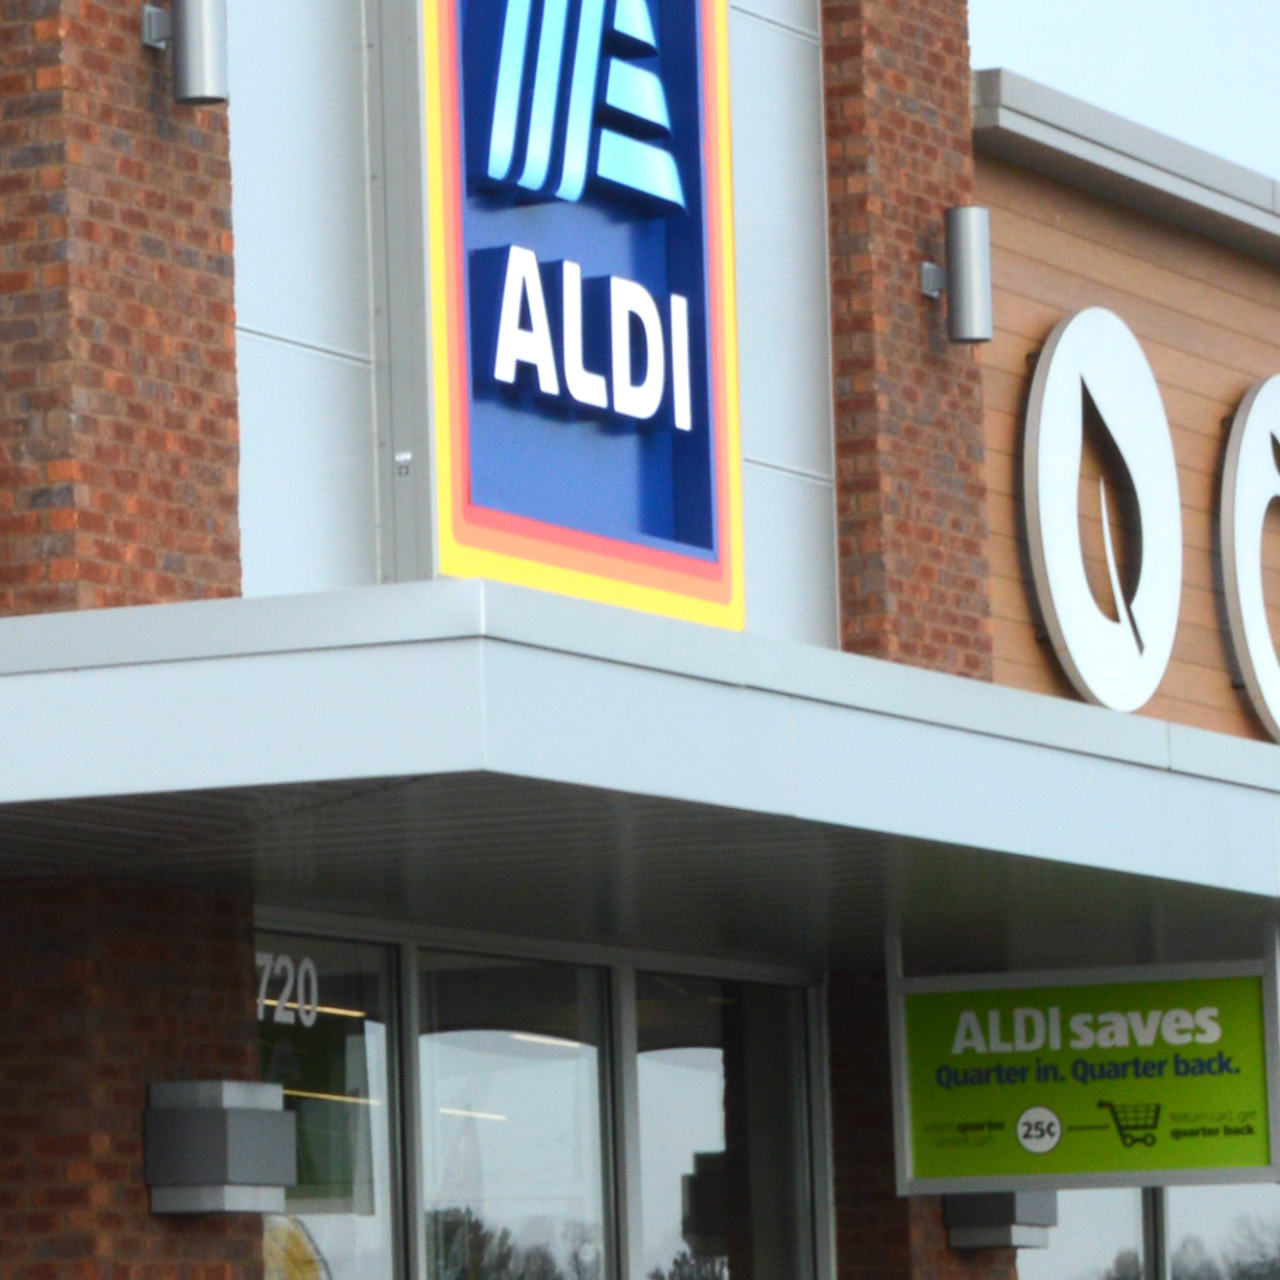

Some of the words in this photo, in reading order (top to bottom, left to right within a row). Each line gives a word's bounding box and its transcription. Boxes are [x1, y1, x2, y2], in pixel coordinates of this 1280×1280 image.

[494, 244, 692, 432] ALDI
[255, 951, 318, 1028] 720
[951, 1006, 1062, 1055] ALDI
[1069, 1006, 1222, 1050] saves
[935, 1063, 1029, 1090] Quarter
[1035, 1057, 1065, 1083] in.
[1071, 1057, 1168, 1084] Quarter
[1174, 1051, 1240, 1077] back.
[1022, 1121, 1056, 1139] 25¢
[1171, 1126, 1219, 1140] quarter
[1223, 1123, 1255, 1136] back
